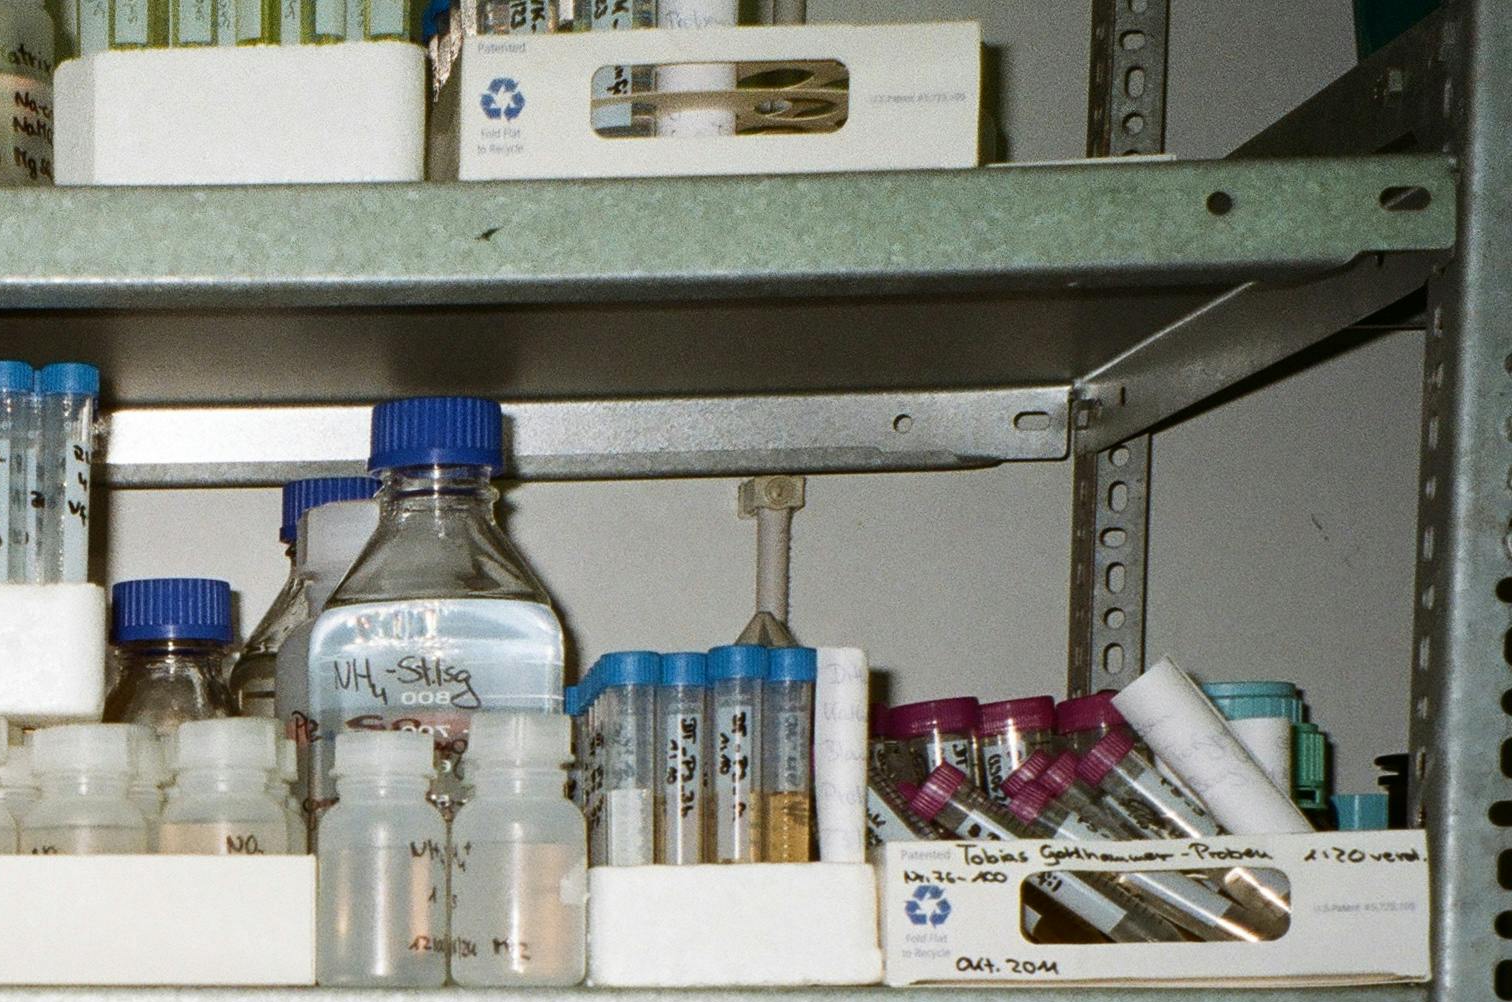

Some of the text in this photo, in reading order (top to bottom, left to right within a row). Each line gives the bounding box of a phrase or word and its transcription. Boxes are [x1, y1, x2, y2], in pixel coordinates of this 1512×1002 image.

[478, 43, 526, 53] Patented
[901, 850, 951, 861] Patented
[956, 843, 1029, 866] Tobias
[905, 934, 948, 945] Fold Flat
[915, 949, 951, 961] Recycle
